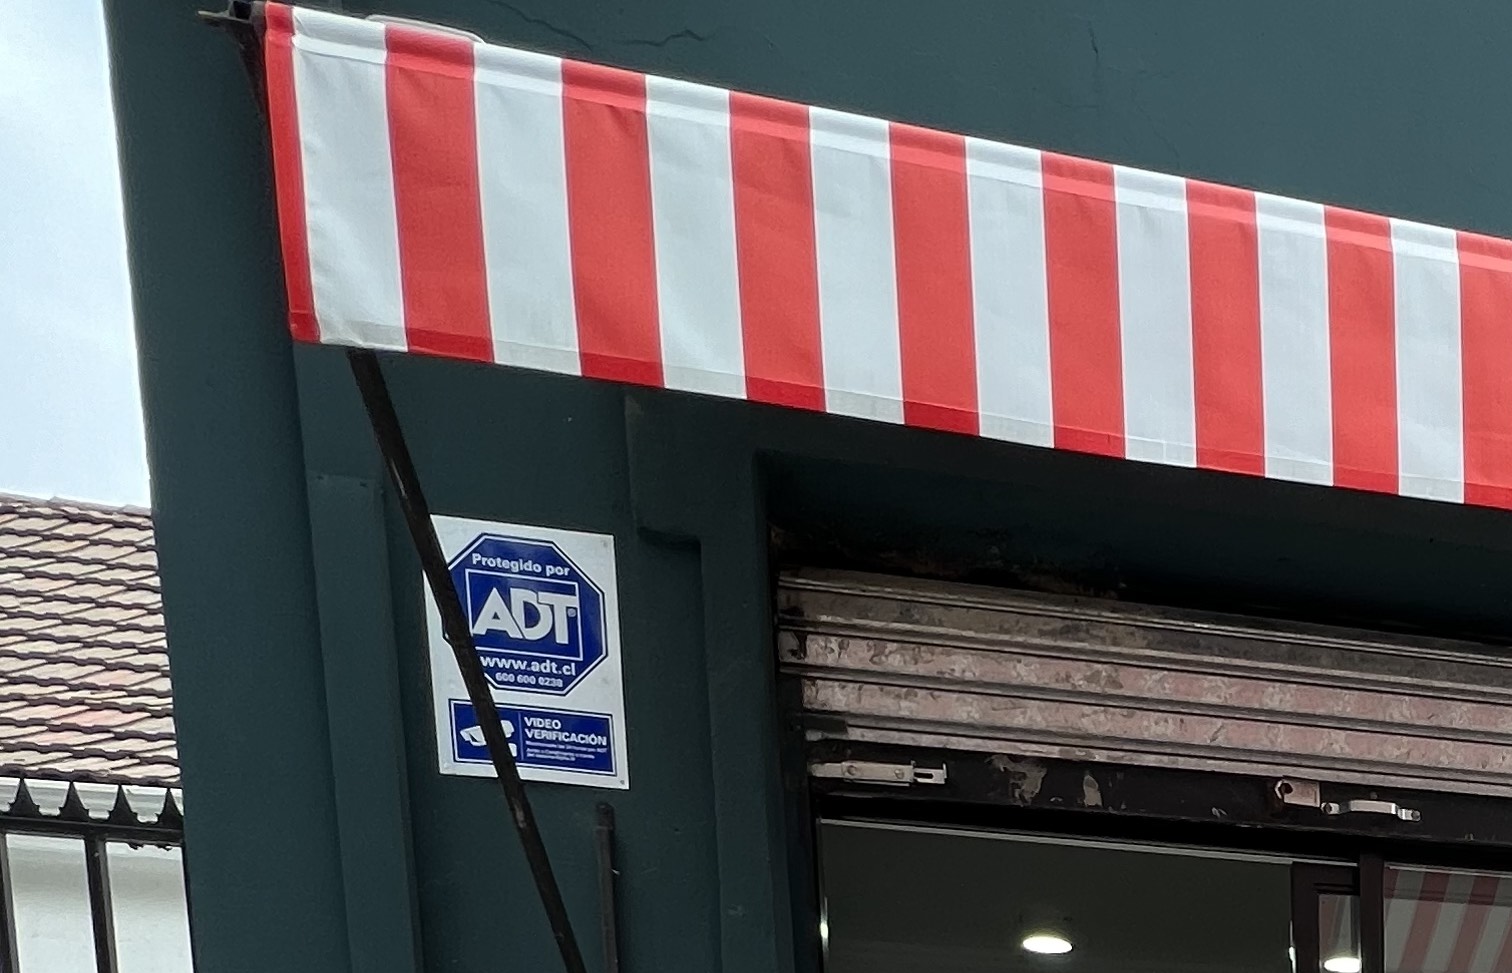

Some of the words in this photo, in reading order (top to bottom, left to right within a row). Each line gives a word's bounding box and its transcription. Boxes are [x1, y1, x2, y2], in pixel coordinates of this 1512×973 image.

[472, 553, 542, 573] Protegido
[545, 564, 570, 577] por
[472, 586, 578, 645] ADT
[480, 656, 576, 676] www.adt.cl
[523, 716, 562, 730] VIDEO
[524, 728, 607, 746] VERIFICACIÓN
